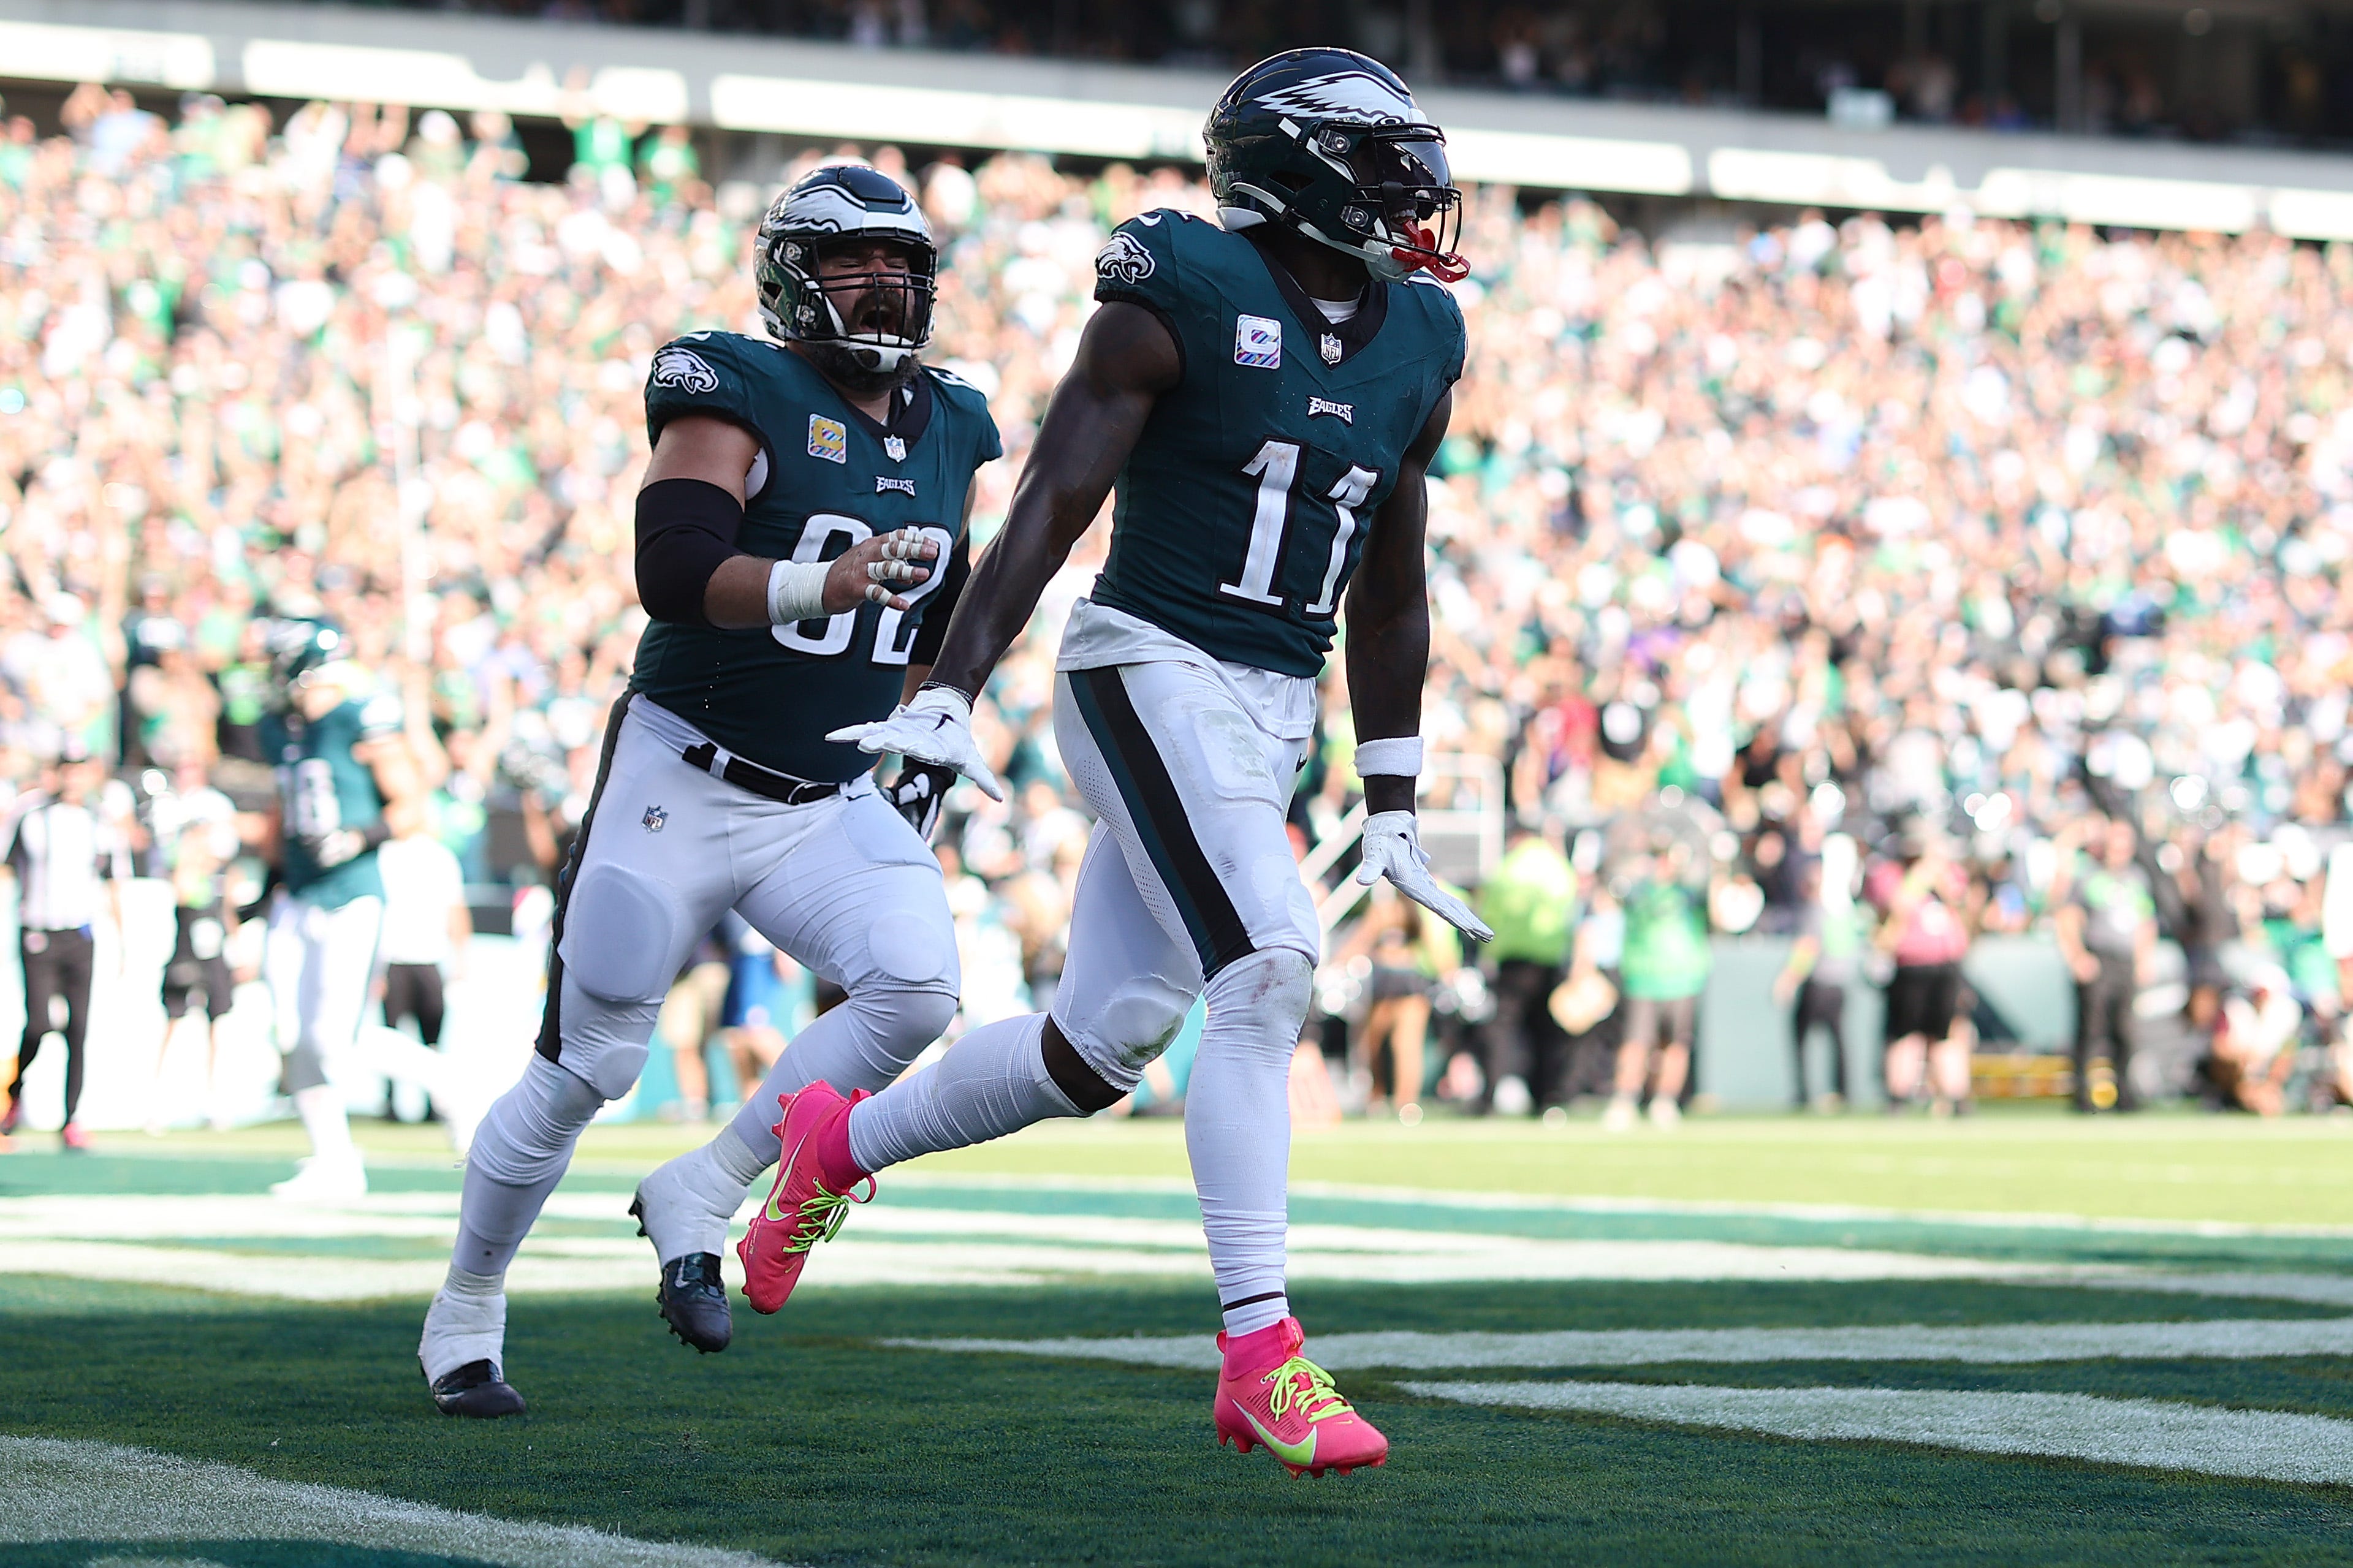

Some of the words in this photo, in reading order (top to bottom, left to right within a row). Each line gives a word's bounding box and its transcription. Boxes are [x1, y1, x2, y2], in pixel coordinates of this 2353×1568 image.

[1241, 320, 1279, 354] C
[1325, 346, 1339, 359] NFL
[1307, 396, 1353, 425] EAGLES
[875, 476, 916, 497] EAGLES
[1220, 440, 1378, 614] 11
